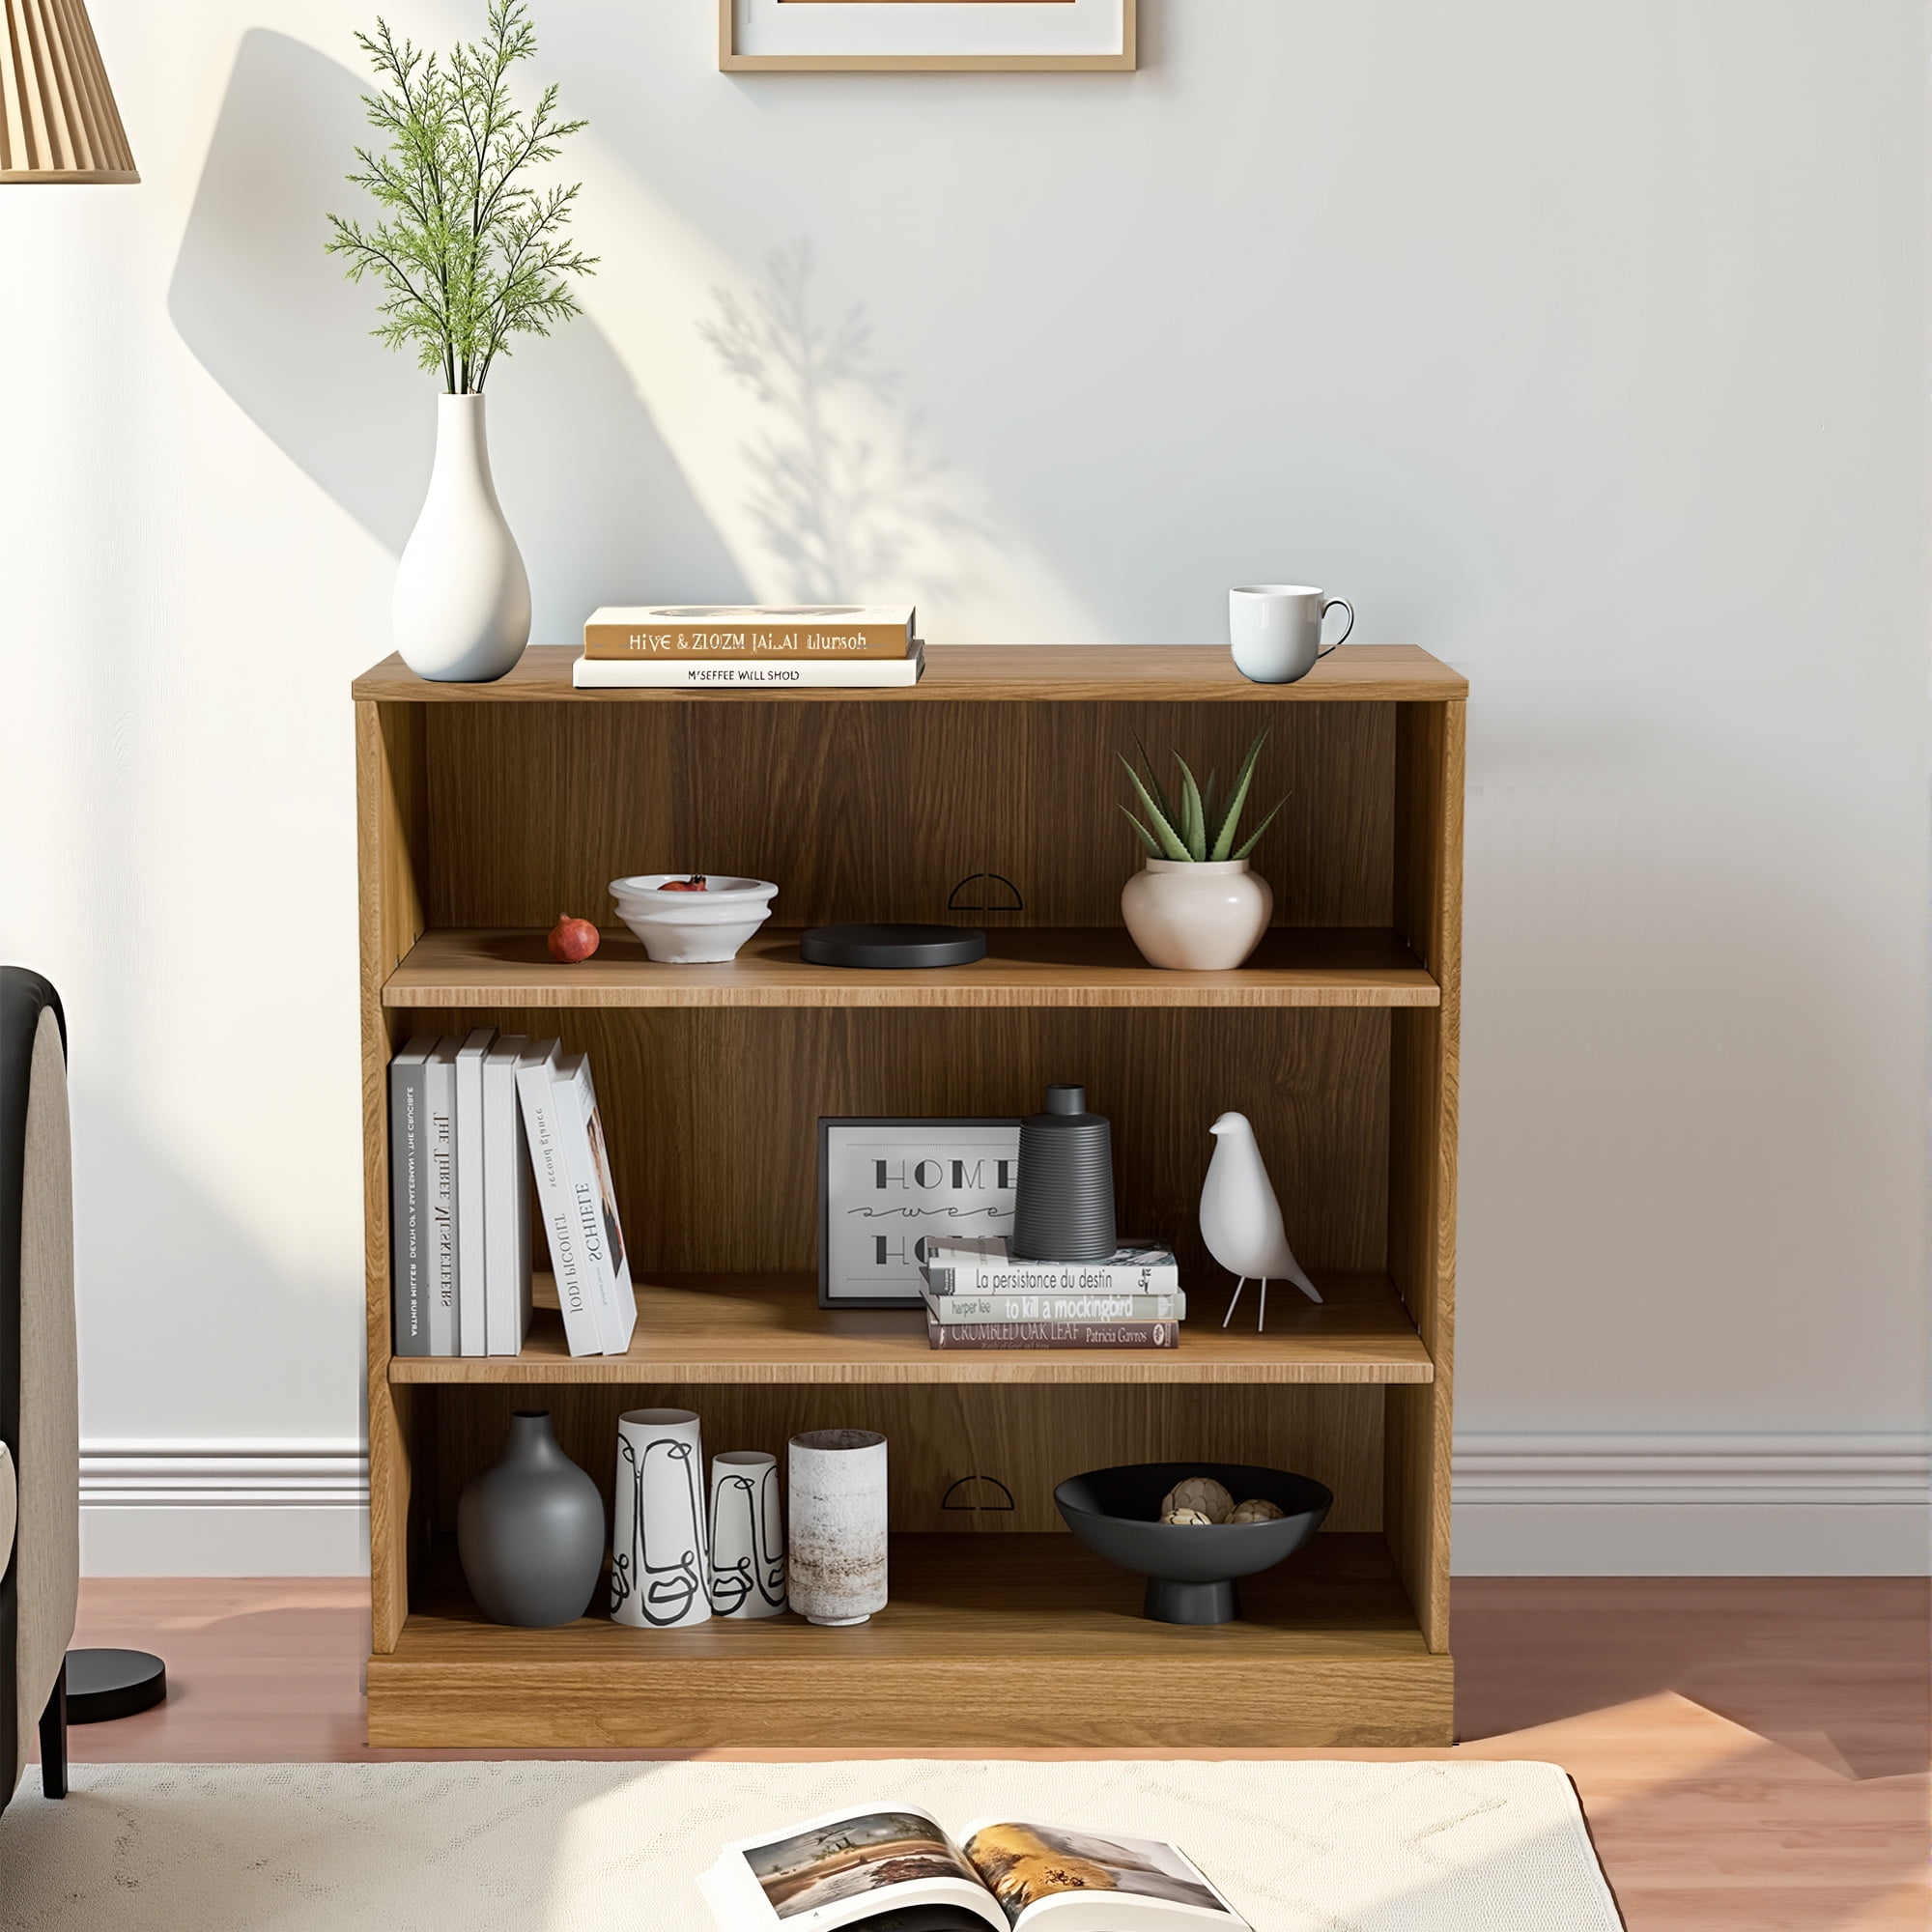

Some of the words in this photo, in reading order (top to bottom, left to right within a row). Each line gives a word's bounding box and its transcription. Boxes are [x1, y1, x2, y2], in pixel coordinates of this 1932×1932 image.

[847, 1207, 1016, 1218] swee
[976, 1268, 988, 1289] La
[992, 1268, 1057, 1295] persistance
[1061, 1268, 1075, 1289] du
[1079, 1268, 1112, 1289] destin
[952, 1299, 977, 1318] harper
[978, 1298, 991, 1314] lee
[1006, 1298, 1019, 1320] to
[1022, 1295, 1039, 1319] kill
[1042, 1300, 1051, 1320] a
[1055, 1294, 1133, 1322] mockingbird
[1020, 1323, 1049, 1341] OAK
[1051, 1321, 1080, 1341] LEAF
[1086, 1326, 1116, 1343] Patricia
